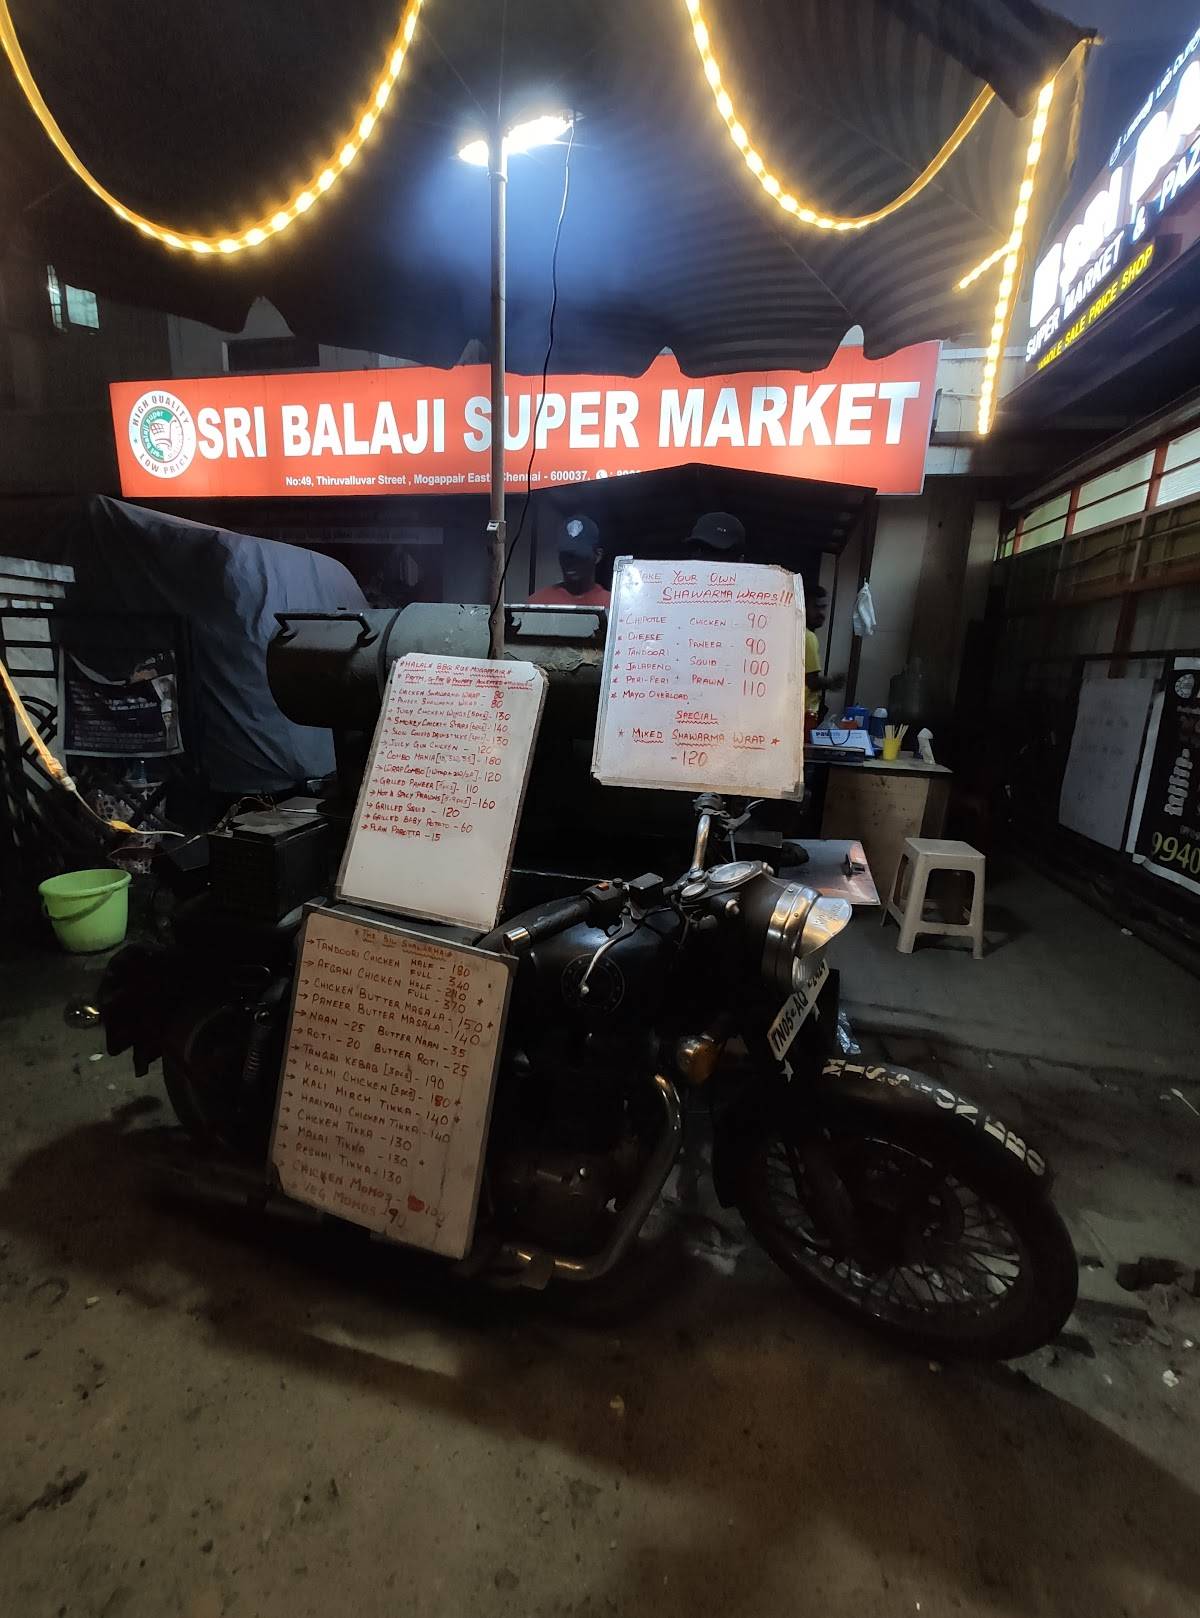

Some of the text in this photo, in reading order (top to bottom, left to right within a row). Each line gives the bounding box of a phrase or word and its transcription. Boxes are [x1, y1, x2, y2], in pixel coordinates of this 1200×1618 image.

[1026, 307, 1060, 362] SUPER
[1063, 230, 1124, 320] MARKET
[1064, 315, 1086, 347] SALE
[1088, 281, 1118, 324] PRICE
[1120, 244, 1154, 290] SHOP
[132, 395, 190, 426] HIGH QUALITY
[198, 405, 267, 460] SRI
[282, 398, 445, 457] BALAJI
[464, 390, 640, 453] SUPER
[658, 381, 921, 448] MARKET
[139, 453, 160, 472] LOW
[285, 476, 313, 487] No:49,
[316, 475, 376, 487] Thiruvalluvar
[377, 474, 407, 485] Street
[413, 473, 465, 486] Mogappair
[673, 570, 736, 583] YOUR OWN
[662, 587, 732, 602] SHAWARMA
[690, 612, 768, 630] CHICKEN 90
[628, 631, 664, 641] CHEESE
[627, 648, 670, 657] TANDOORI
[745, 637, 767, 655] 90
[625, 662, 672, 672] JALAPENO
[689, 656, 770, 676] SQUID 100
[494, 690, 505, 700] 80
[691, 674, 766, 697] PRAWN 110
[490, 700, 504, 709] 80
[622, 690, 689, 701] MAYO OVERLOAD
[675, 710, 719, 721] SPECIAL
[493, 723, 510, 733] 140
[631, 728, 766, 745] MIXED SHAWARMA WRAP
[485, 756, 502, 766] 180
[380, 777, 406, 786] GRILLED
[466, 784, 479, 794] 110
[484, 771, 502, 783] 120
[375, 801, 403, 812] GRILLED
[442, 807, 461, 818] 120
[478, 798, 496, 810] 160
[370, 822, 388, 832] PLAIN
[372, 812, 399, 822] GRILLED
[403, 814, 422, 825] BABY
[316, 939, 471, 977] TANDOORI CHICKEN HALF 180
[317, 959, 432, 991] AFGANI CHICKEN HALF
[410, 969, 470, 991] FULL 340
[314, 978, 483, 1033] CHICKEN BUTTER MASALA 150
[407, 989, 466, 1014] FULL 370
[311, 993, 481, 1047] PANEER BUTTER MASALA 140
[310, 1011, 338, 1026] NAAN
[377, 1025, 412, 1043] BUTTER
[414, 1035, 440, 1051] NAAN
[306, 1027, 331, 1041] ROTI
[374, 1043, 411, 1060] BUTTER
[417, 1052, 439, 1068] ROTI
[302, 1044, 445, 1090] TANGRI KEBAB 190
[304, 1061, 336, 1079] KALMI
[342, 1071, 388, 1092] CHICKEN
[302, 1077, 449, 1126] KALI MIRCH TIKKA 140
[301, 1095, 451, 1143] HARIYALI CHICKEN TIKKA 140
[297, 1108, 412, 1151] CHICKEN TIKKA 130
[297, 1126, 328, 1144] MALAI
[388, 1153, 409, 1168] 130
[292, 1160, 344, 1185] CHICKEN
[295, 1142, 402, 1185] RESHMI TIKKA 130
